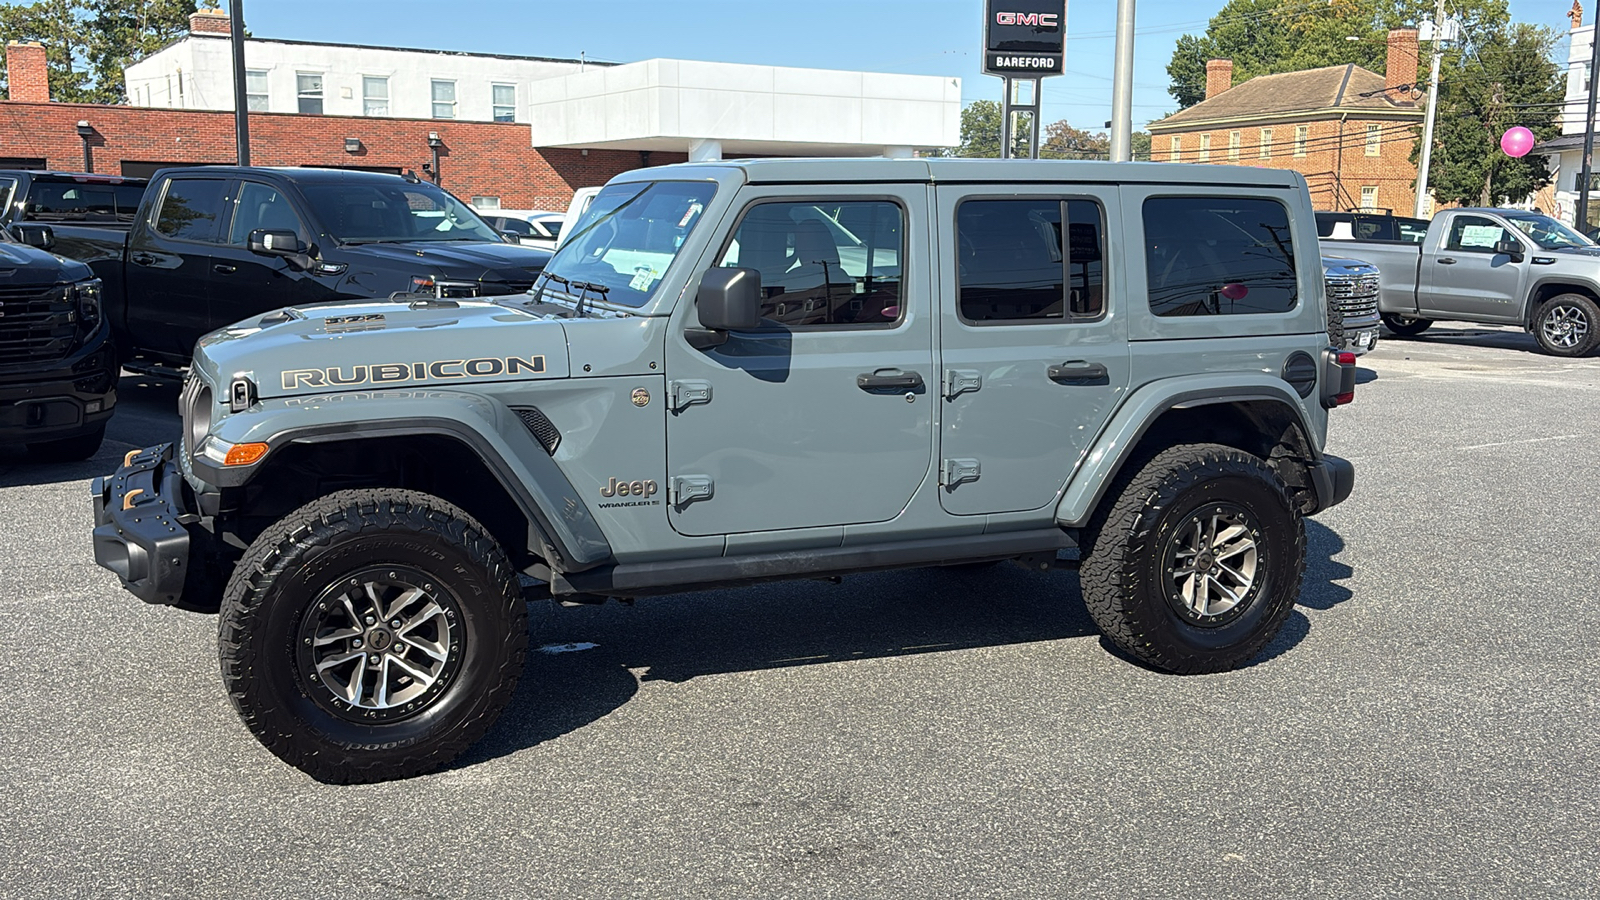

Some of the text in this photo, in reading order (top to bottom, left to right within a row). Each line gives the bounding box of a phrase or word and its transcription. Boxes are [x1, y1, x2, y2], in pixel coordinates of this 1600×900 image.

[997, 12, 1058, 26] GMC
[996, 56, 1055, 68] BAREFORD
[281, 355, 546, 390] RUBICON
[600, 477, 658, 498] Jeep
